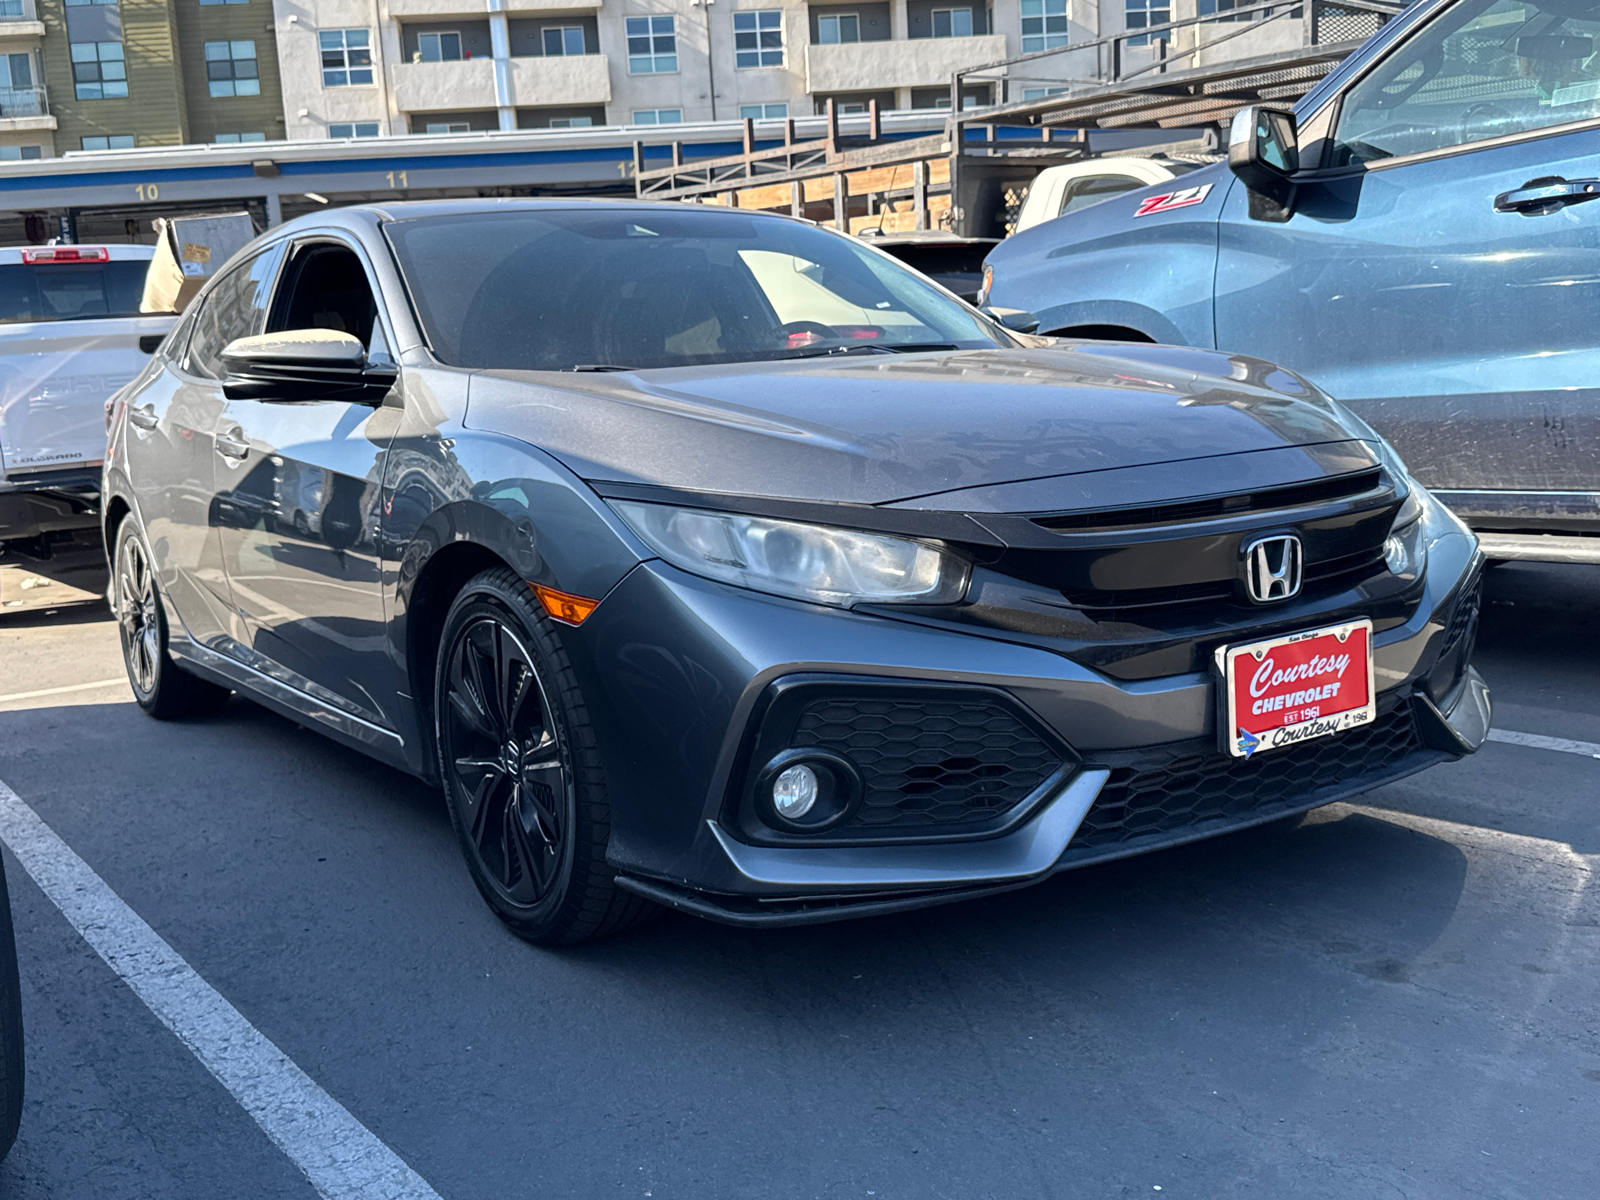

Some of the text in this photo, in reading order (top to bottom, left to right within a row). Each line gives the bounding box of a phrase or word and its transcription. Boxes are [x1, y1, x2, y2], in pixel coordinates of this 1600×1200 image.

[136, 184, 158, 200] 10
[386, 171, 408, 188] 11
[1133, 183, 1214, 218] Z71
[1301, 632, 1319, 640] Diego
[1249, 653, 1351, 698] Courtesy
[1252, 682, 1341, 715] CHEVROLET
[1283, 706, 1320, 724] EST 1961
[1271, 711, 1368, 747] Courtesy 1961
